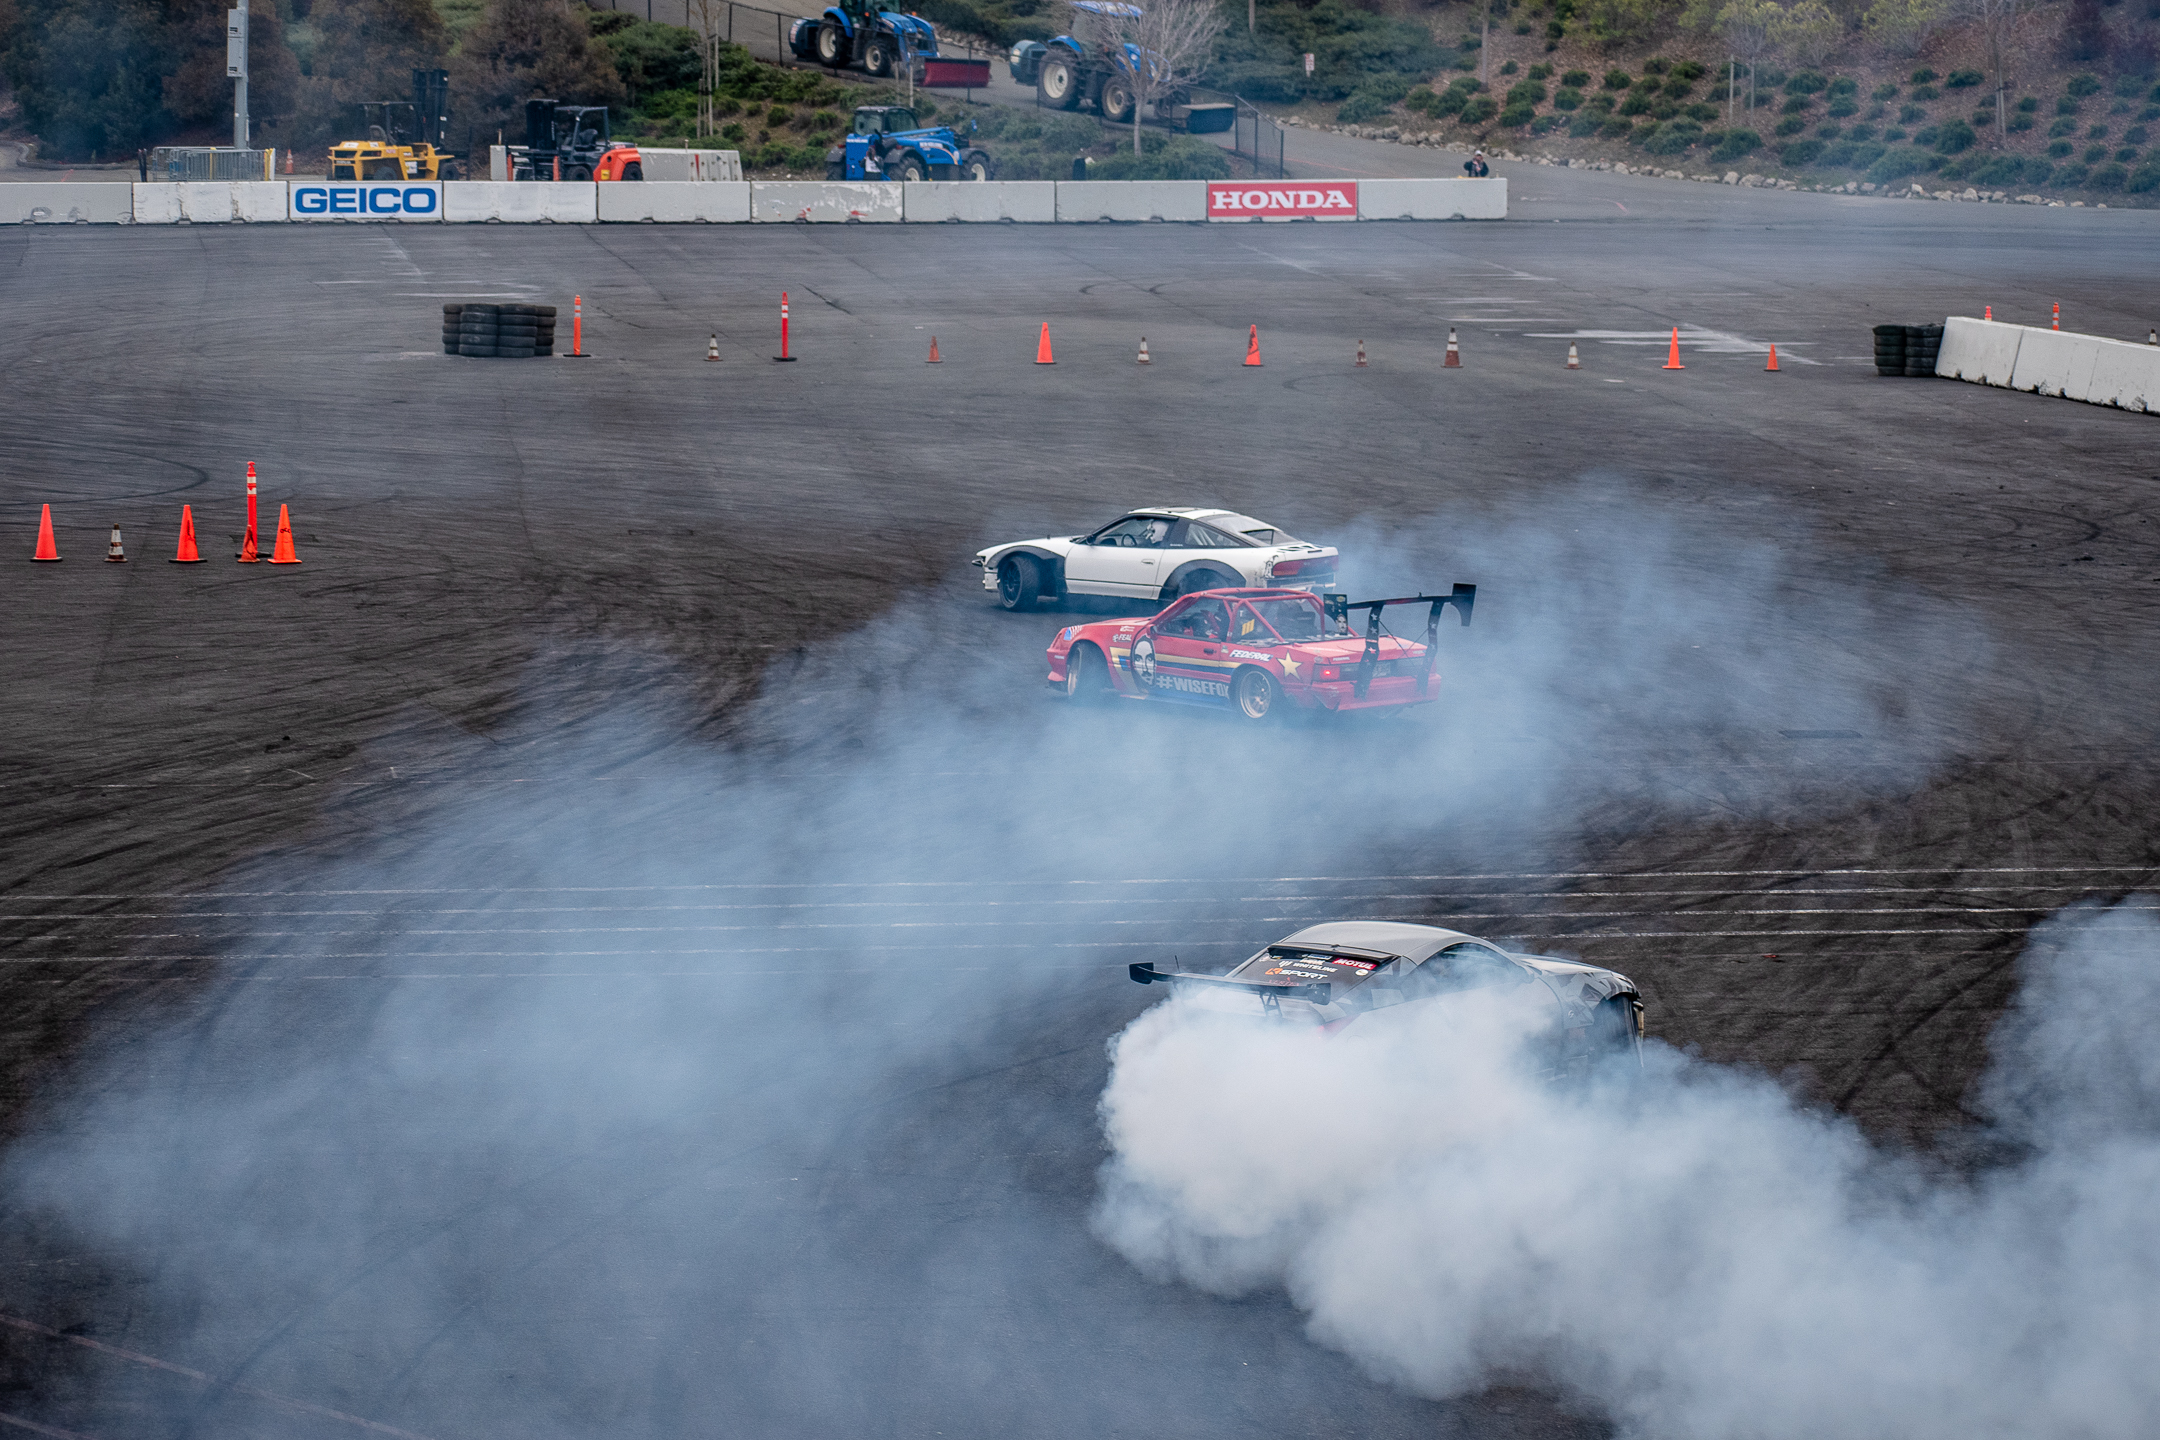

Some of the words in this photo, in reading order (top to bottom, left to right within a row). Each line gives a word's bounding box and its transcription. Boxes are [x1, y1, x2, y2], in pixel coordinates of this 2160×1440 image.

[295, 188, 436, 213] GEICO
[1212, 190, 1353, 209] HONDA
[1229, 649, 1273, 662] FEDERAL
[1293, 962, 1338, 973] WHITELINE
[1334, 958, 1374, 969] MOTUL
